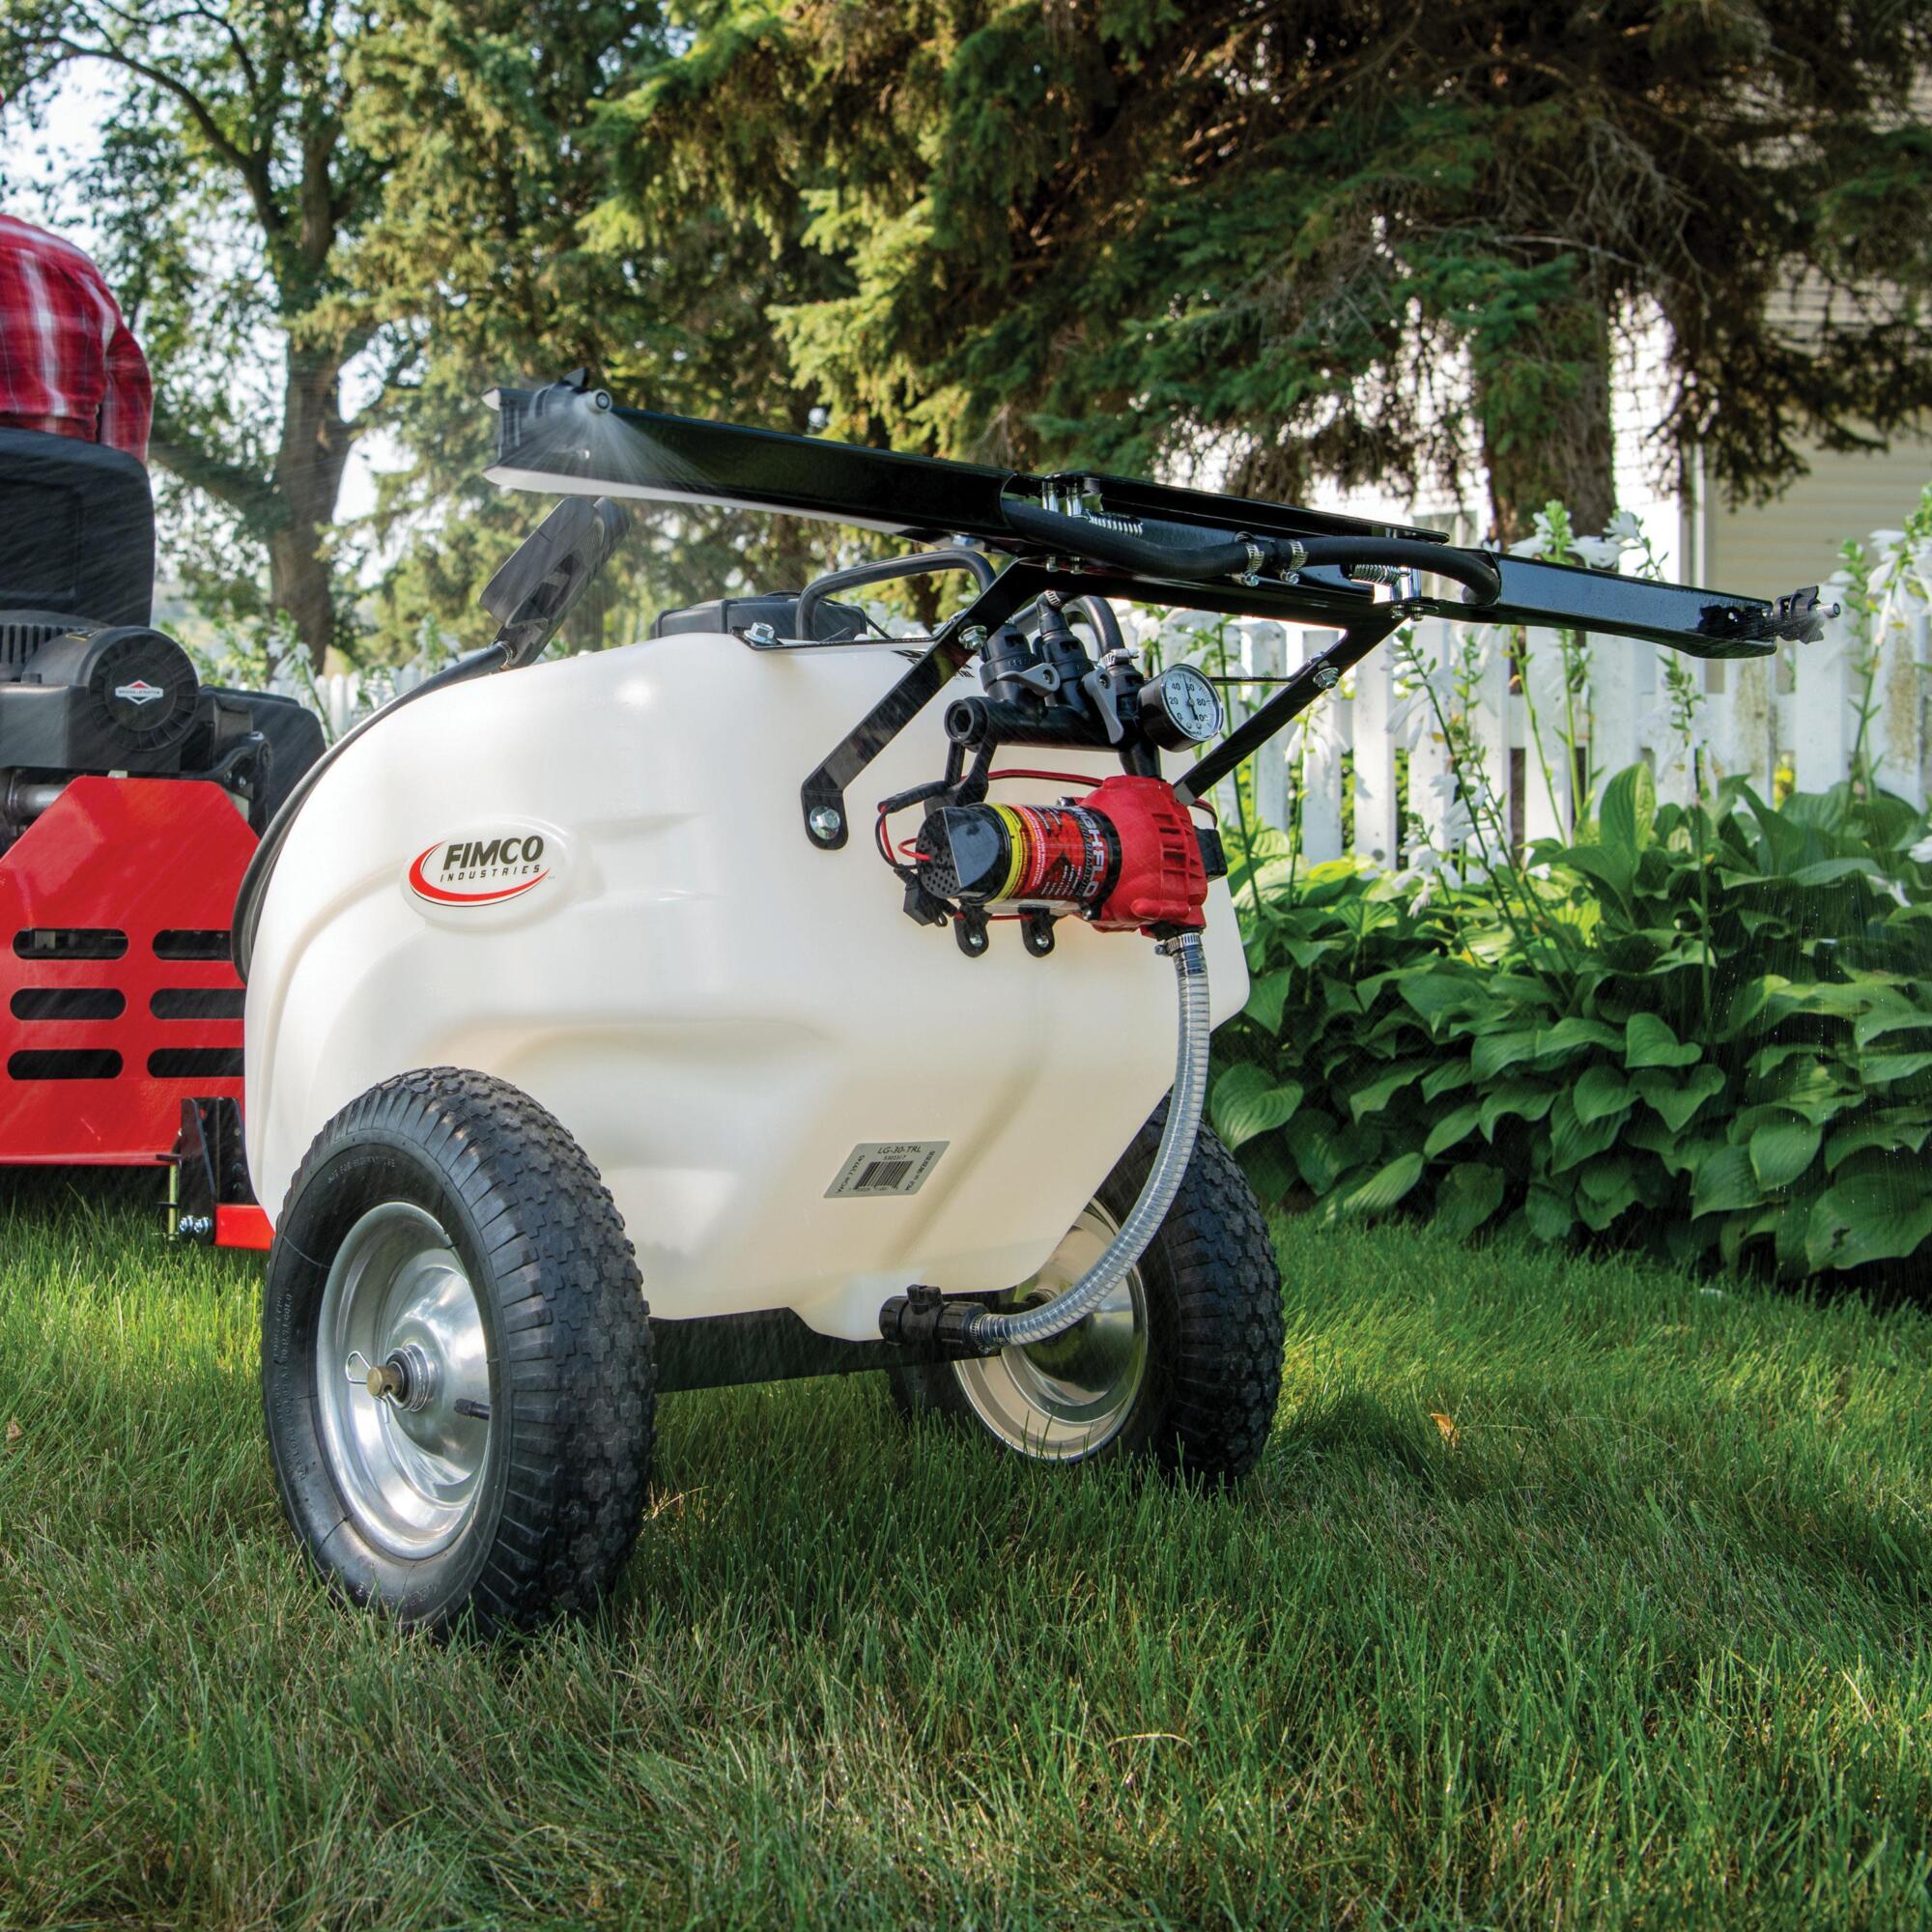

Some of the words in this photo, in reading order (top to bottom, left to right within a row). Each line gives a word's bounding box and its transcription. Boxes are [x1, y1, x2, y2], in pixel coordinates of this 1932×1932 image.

[1169, 696, 1179, 705] 20
[442, 835, 544, 870] FIMCO
[440, 865, 541, 883] INDUSTRIES
[877, 1146, 922, 1154] LG-30-TRL
